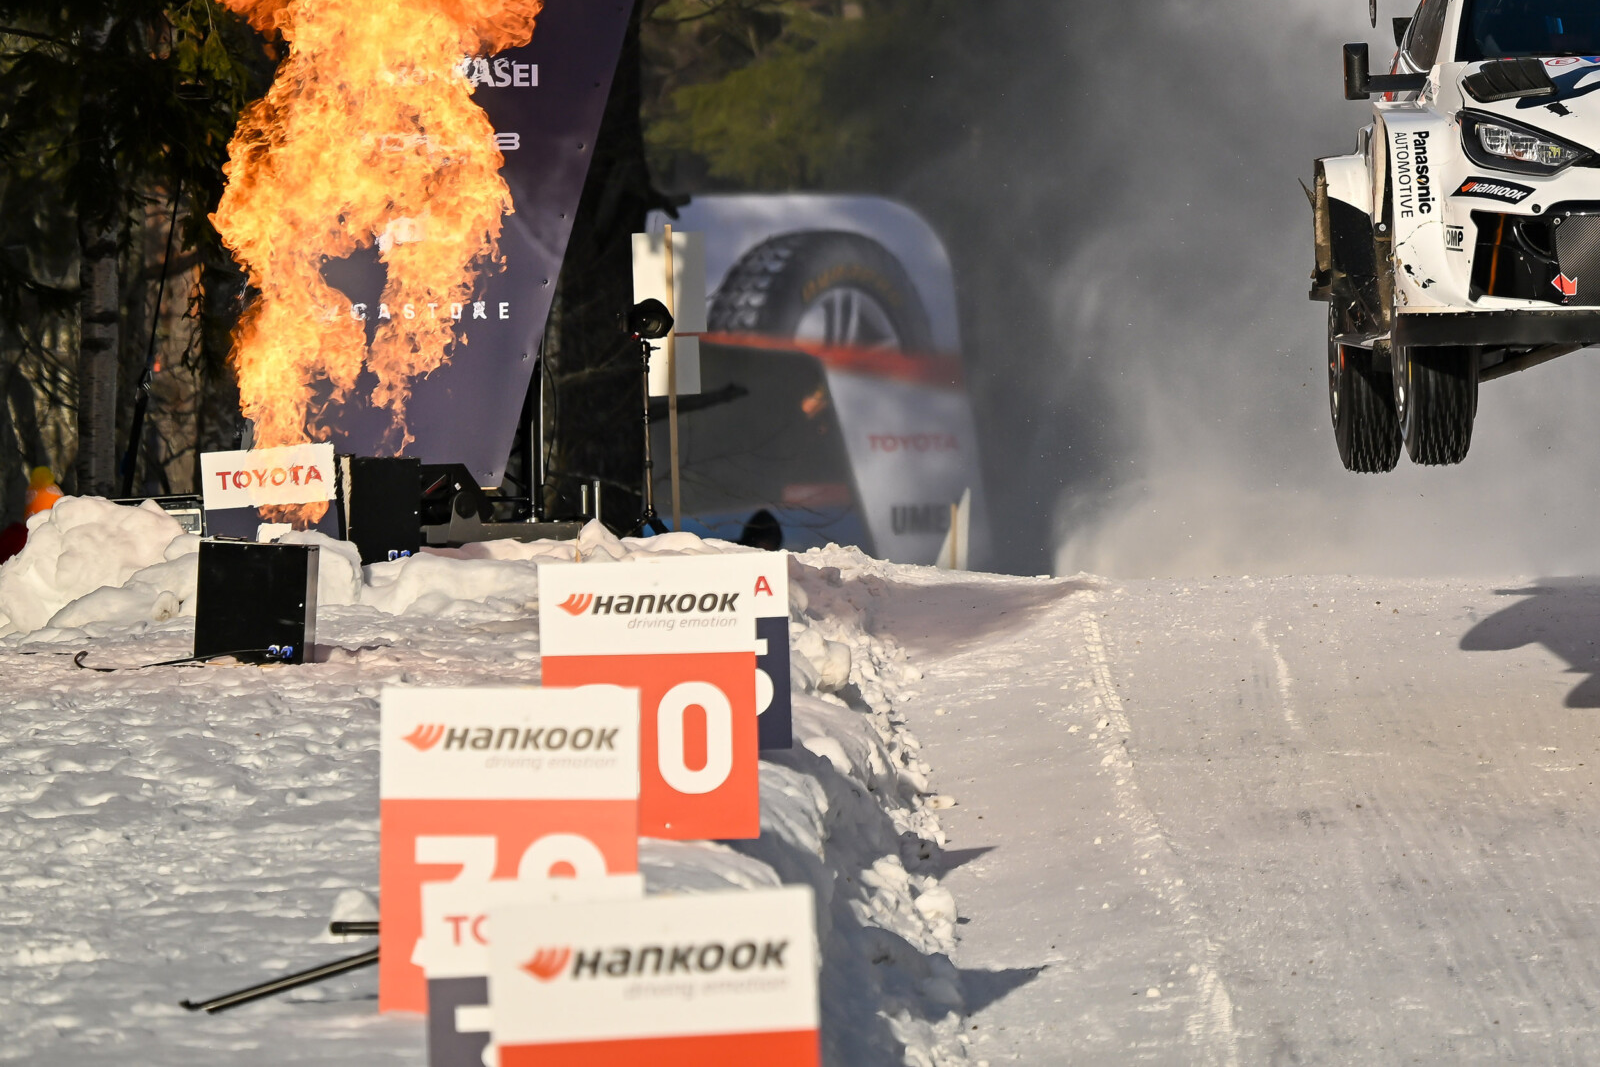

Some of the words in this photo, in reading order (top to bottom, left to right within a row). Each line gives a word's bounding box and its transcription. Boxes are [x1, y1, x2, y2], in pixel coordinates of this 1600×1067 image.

[1394, 132, 1414, 218] AUTOMOTIVE
[1413, 131, 1435, 214] Panasonic
[1446, 230, 1464, 247] OMP
[867, 433, 959, 452] TOYOTA
[216, 465, 323, 490] TOYOTA
[627, 617, 676, 632] driving
[679, 616, 737, 630] emotion
[656, 681, 733, 794] 0
